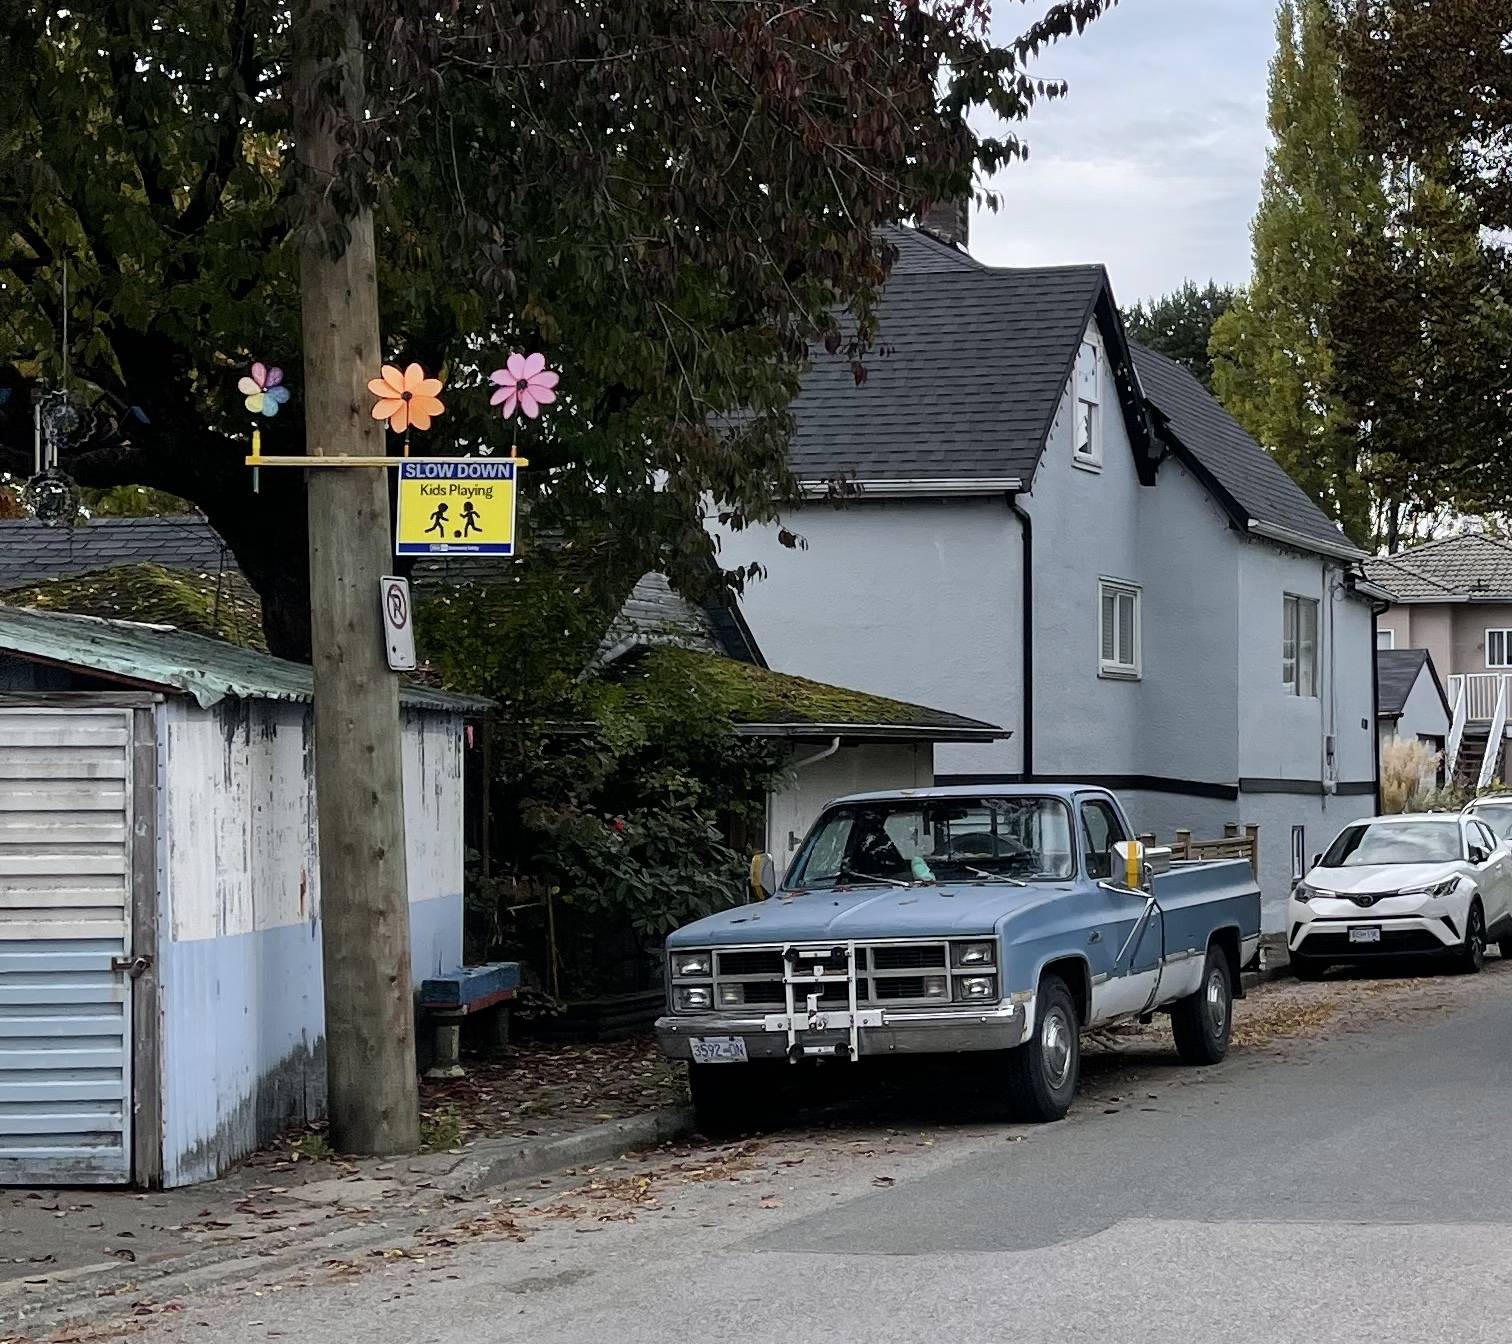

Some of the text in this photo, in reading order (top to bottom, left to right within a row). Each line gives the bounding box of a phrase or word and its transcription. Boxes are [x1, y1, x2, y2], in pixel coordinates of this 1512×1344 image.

[405, 464, 510, 478] SLOW DOWN
[420, 484, 494, 499] Kids Playing
